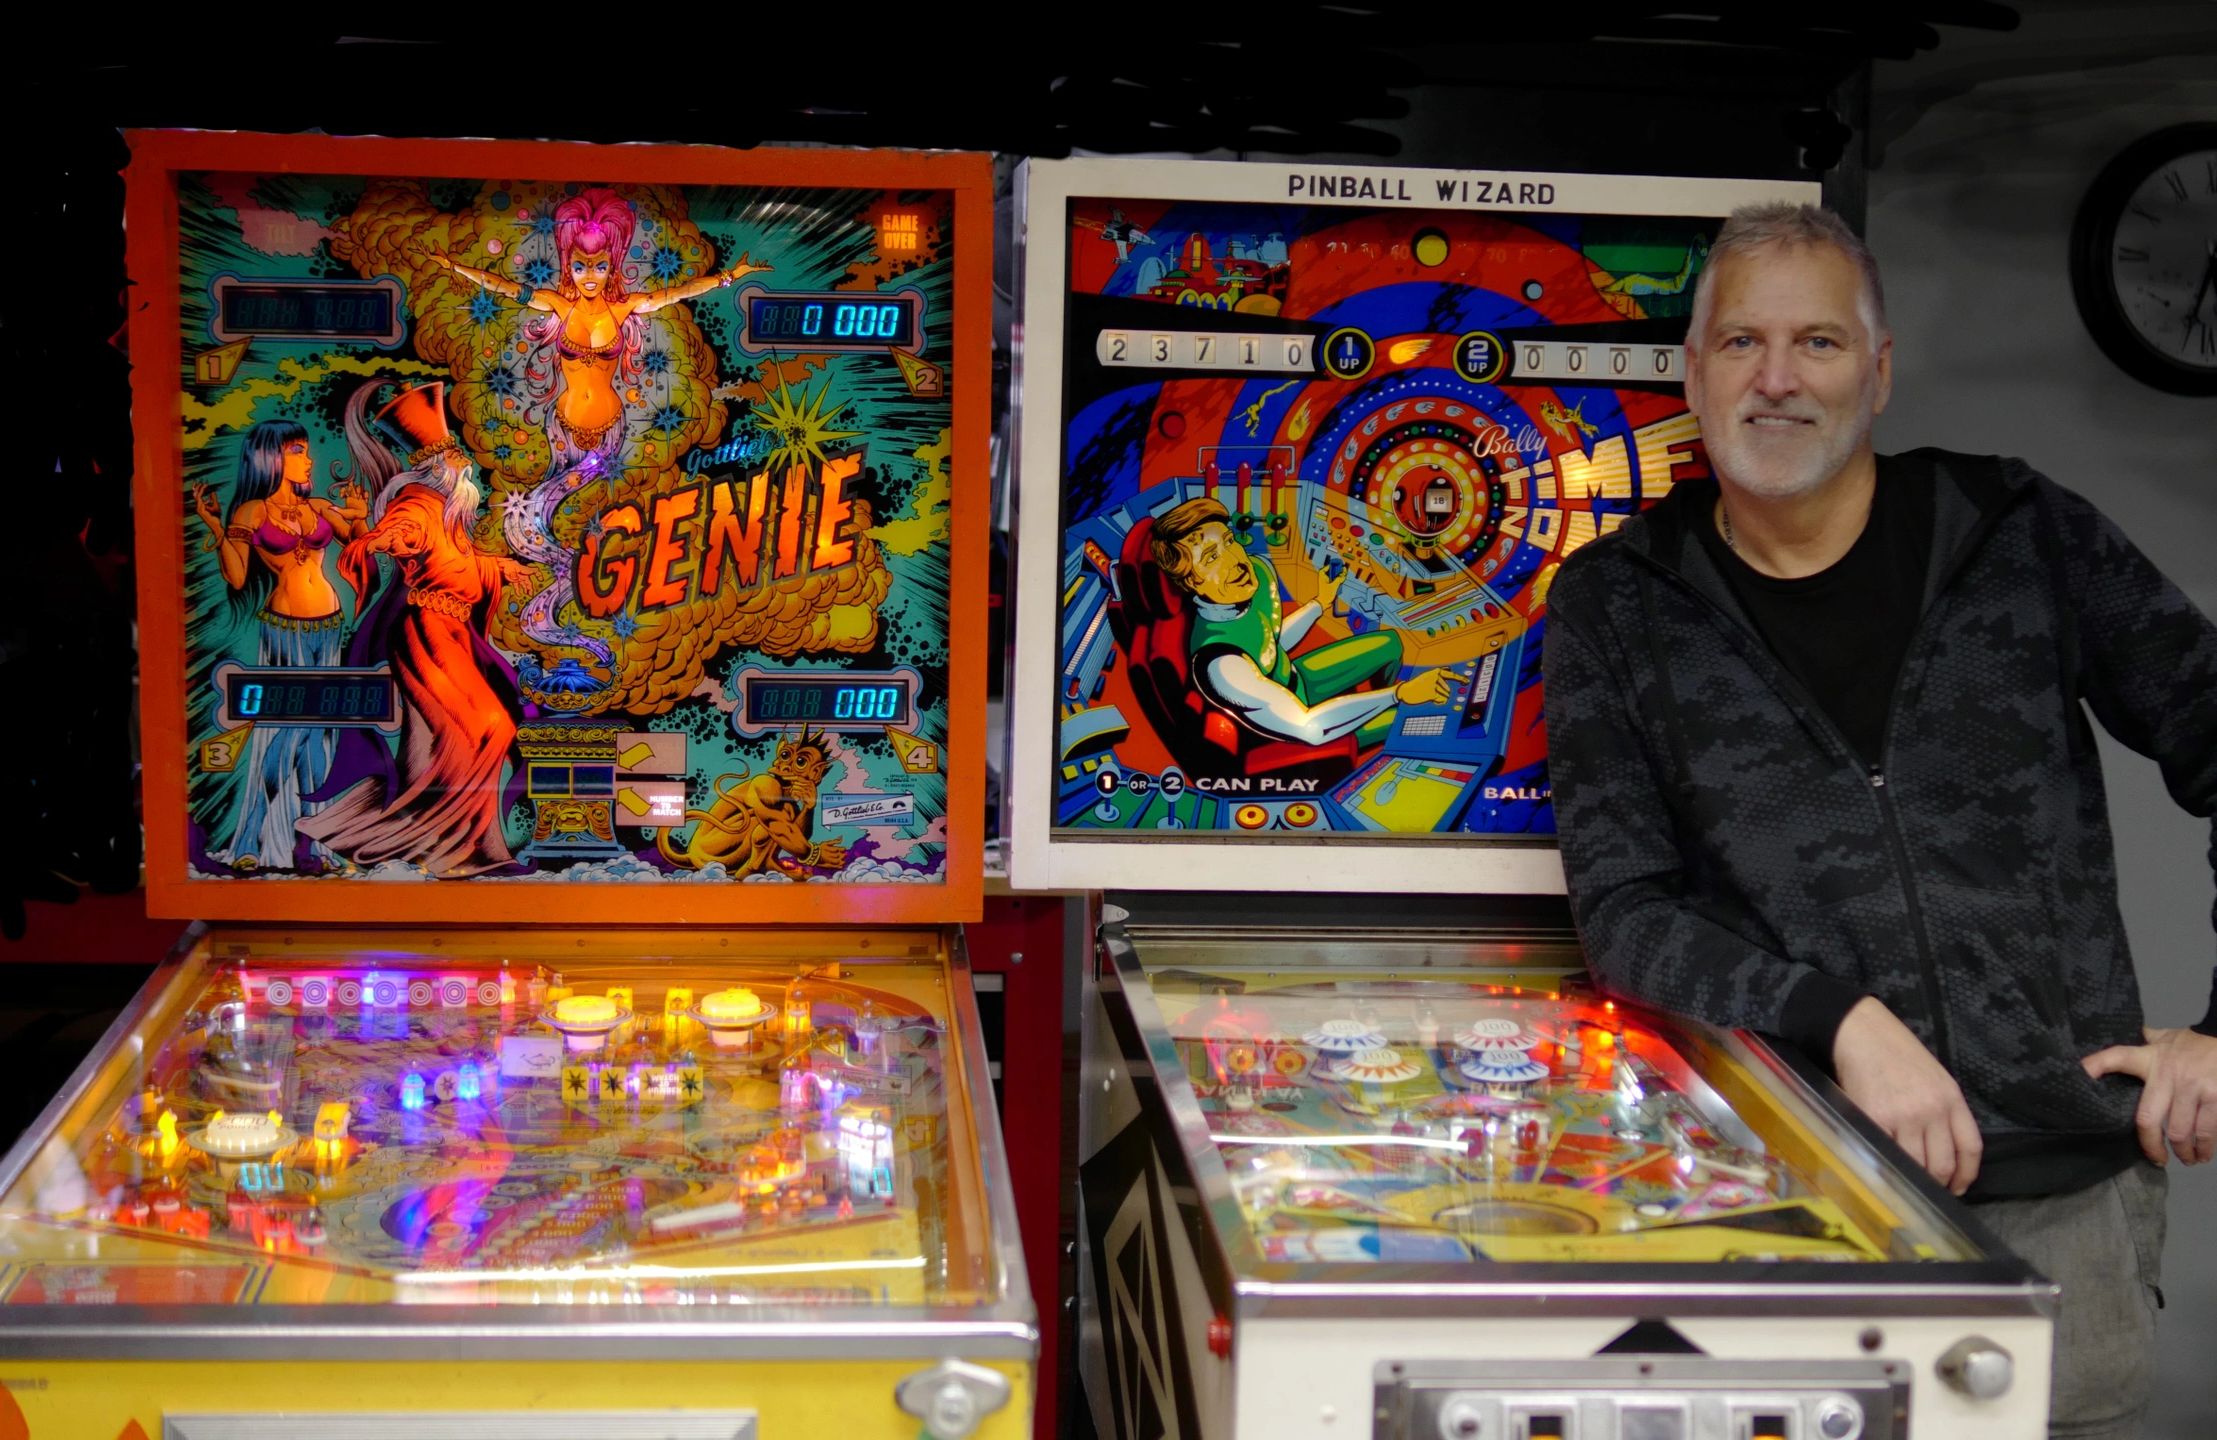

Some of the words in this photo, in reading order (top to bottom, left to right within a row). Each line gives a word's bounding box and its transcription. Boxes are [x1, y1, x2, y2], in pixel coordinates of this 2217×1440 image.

[1288, 174, 1412, 201] PINBALL
[1436, 179, 1555, 205] WIZARD
[882, 214, 919, 232] GAME
[265, 224, 296, 246] TILT
[884, 232, 917, 249] OVER
[1344, 336, 1353, 356] 1
[1468, 340, 1489, 360] 2
[206, 356, 222, 380] 1
[1338, 358, 1360, 370] UP
[1467, 362, 1488, 373] UP
[915, 368, 939, 391] 2
[1473, 424, 1548, 460] Bally
[686, 426, 787, 482] Gottlieb's
[576, 450, 864, 619] GENIE
[834, 687, 898, 718] 000
[207, 741, 233, 767] 3
[906, 745, 933, 768] 4
[1102, 775, 1112, 789] 1
[1130, 780, 1148, 790] OR
[1165, 778, 1181, 790] 2
[1195, 777, 1250, 791] CAN
[1260, 779, 1320, 792] PLAY
[1483, 787, 1542, 800] BALL
[649, 795, 684, 803] NUMBER
